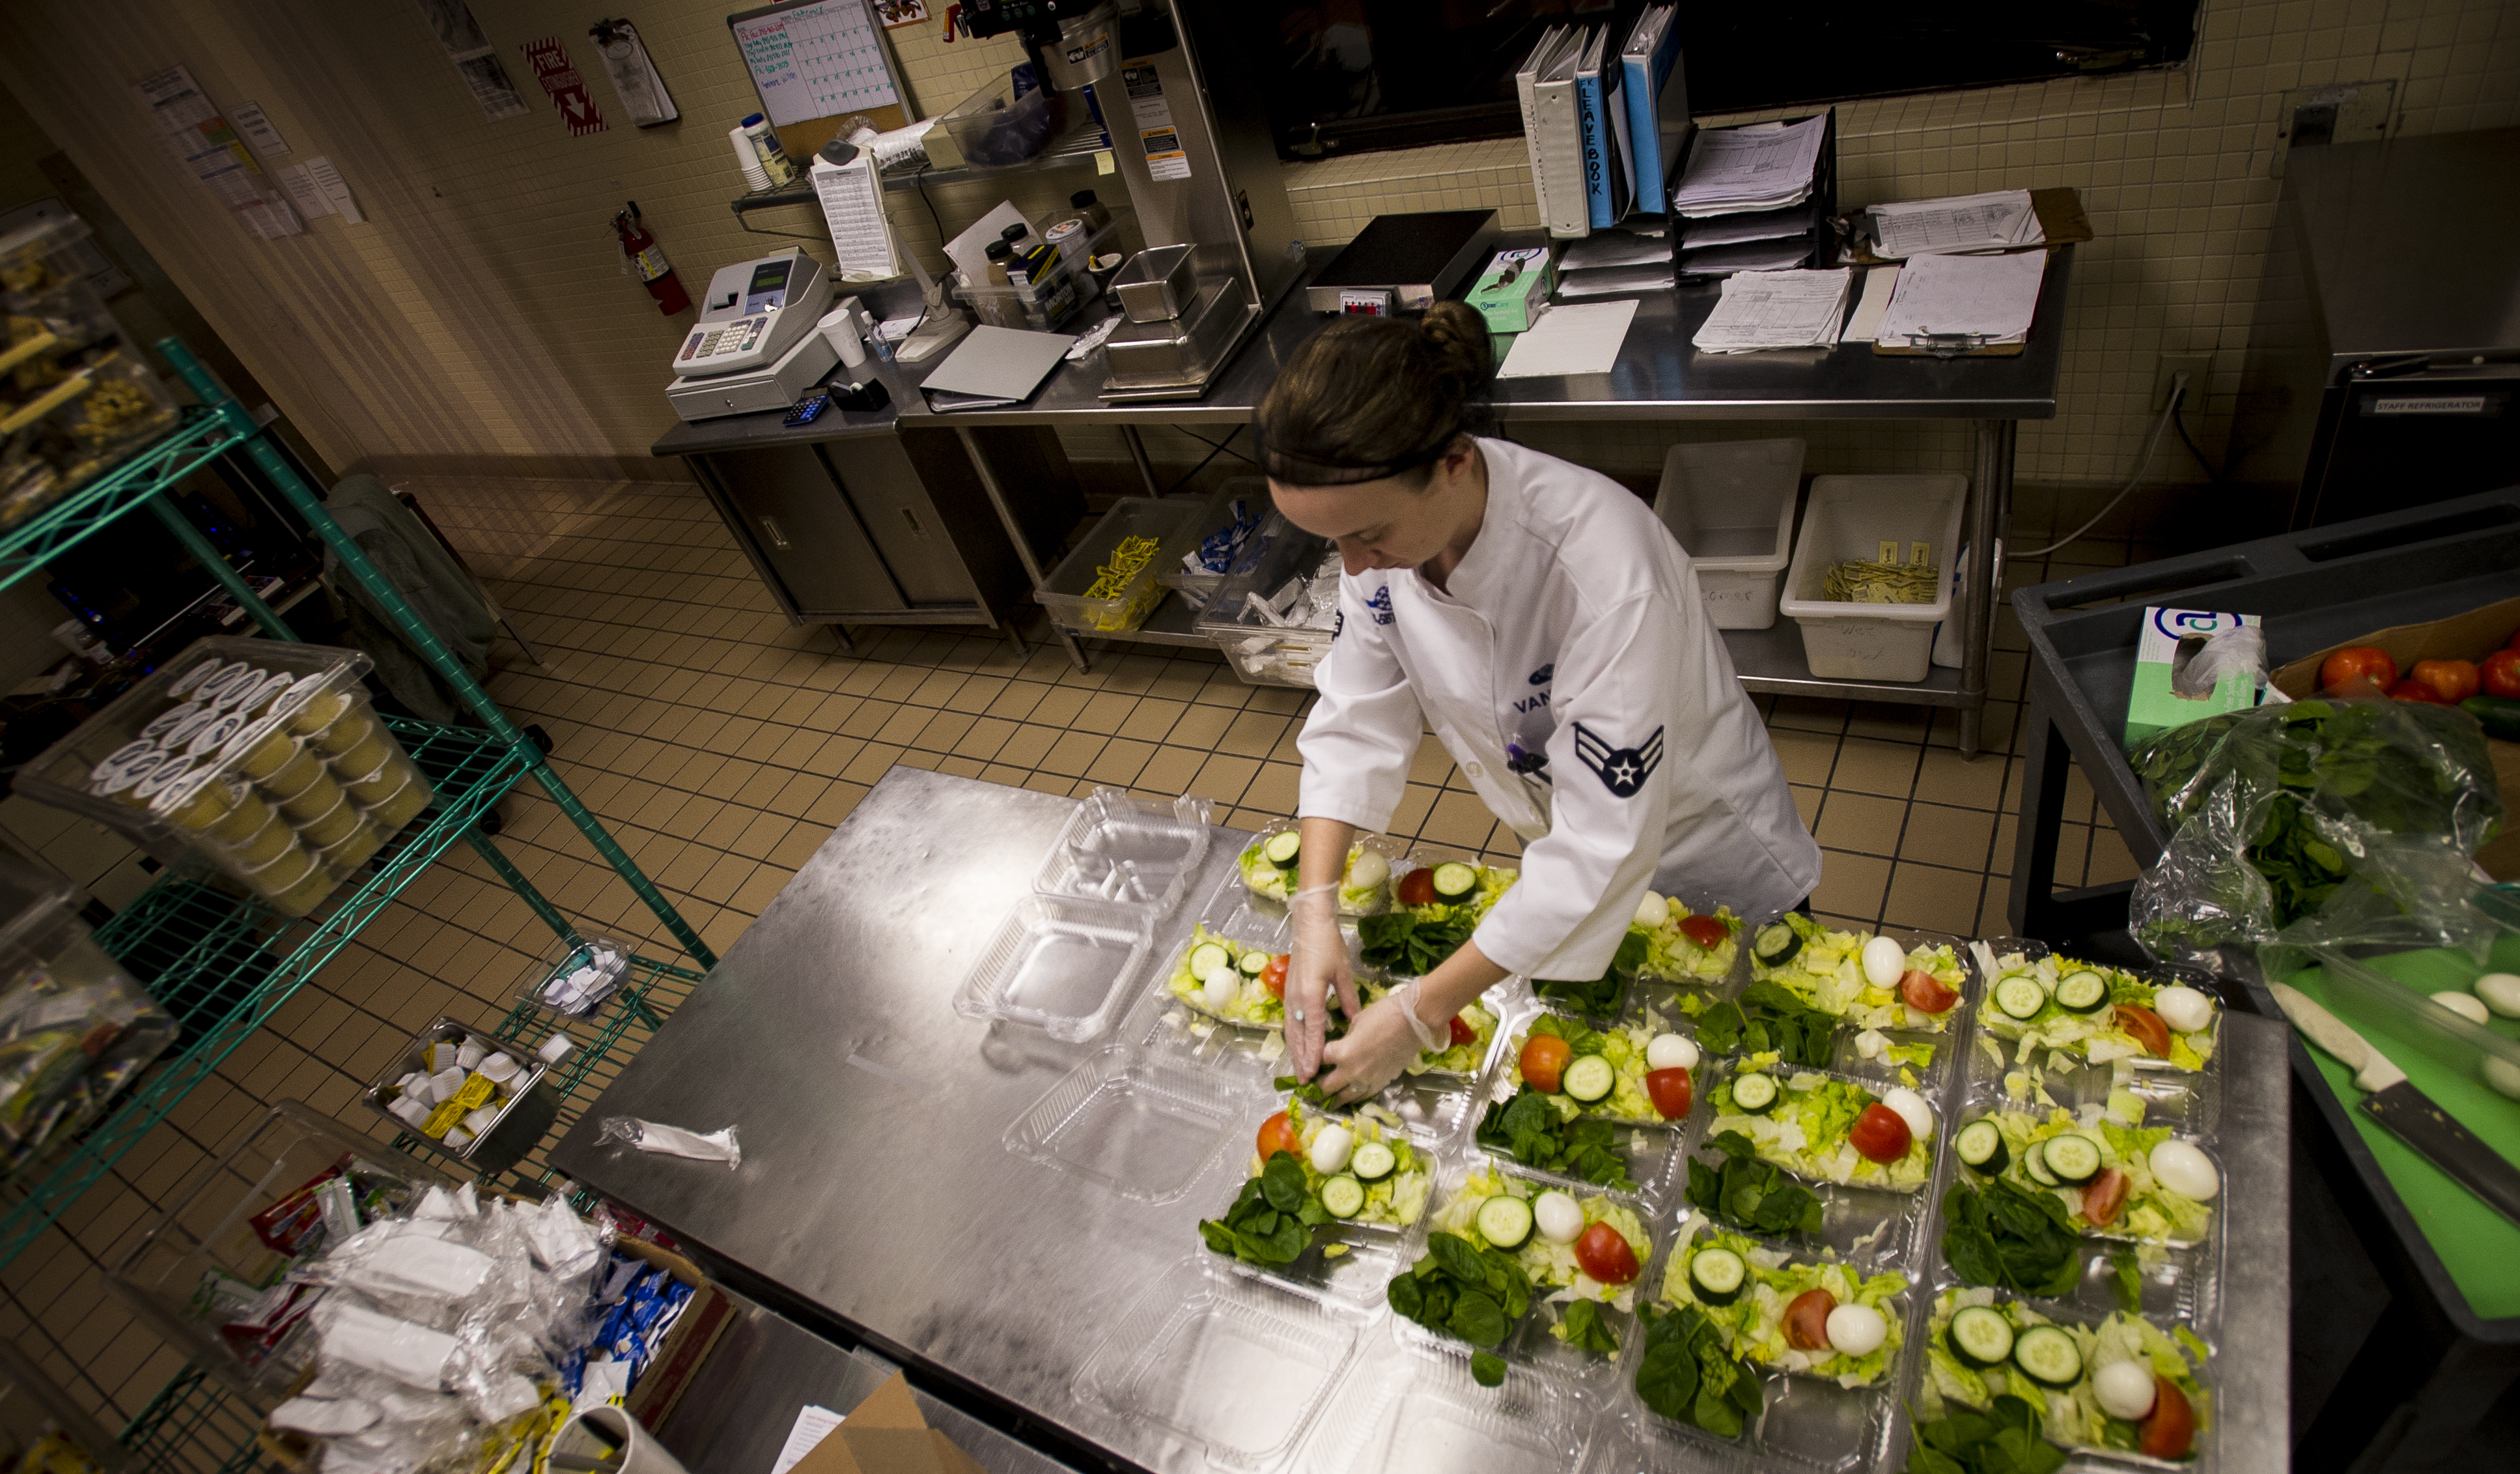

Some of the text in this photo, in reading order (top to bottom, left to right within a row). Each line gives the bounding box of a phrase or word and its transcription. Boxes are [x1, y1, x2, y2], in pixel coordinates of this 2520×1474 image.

[535, 50, 565, 71] FIRE
[1044, 281, 1074, 311] MORTON
[2377, 401, 2481, 410] STAFF REFRIGERATOR
